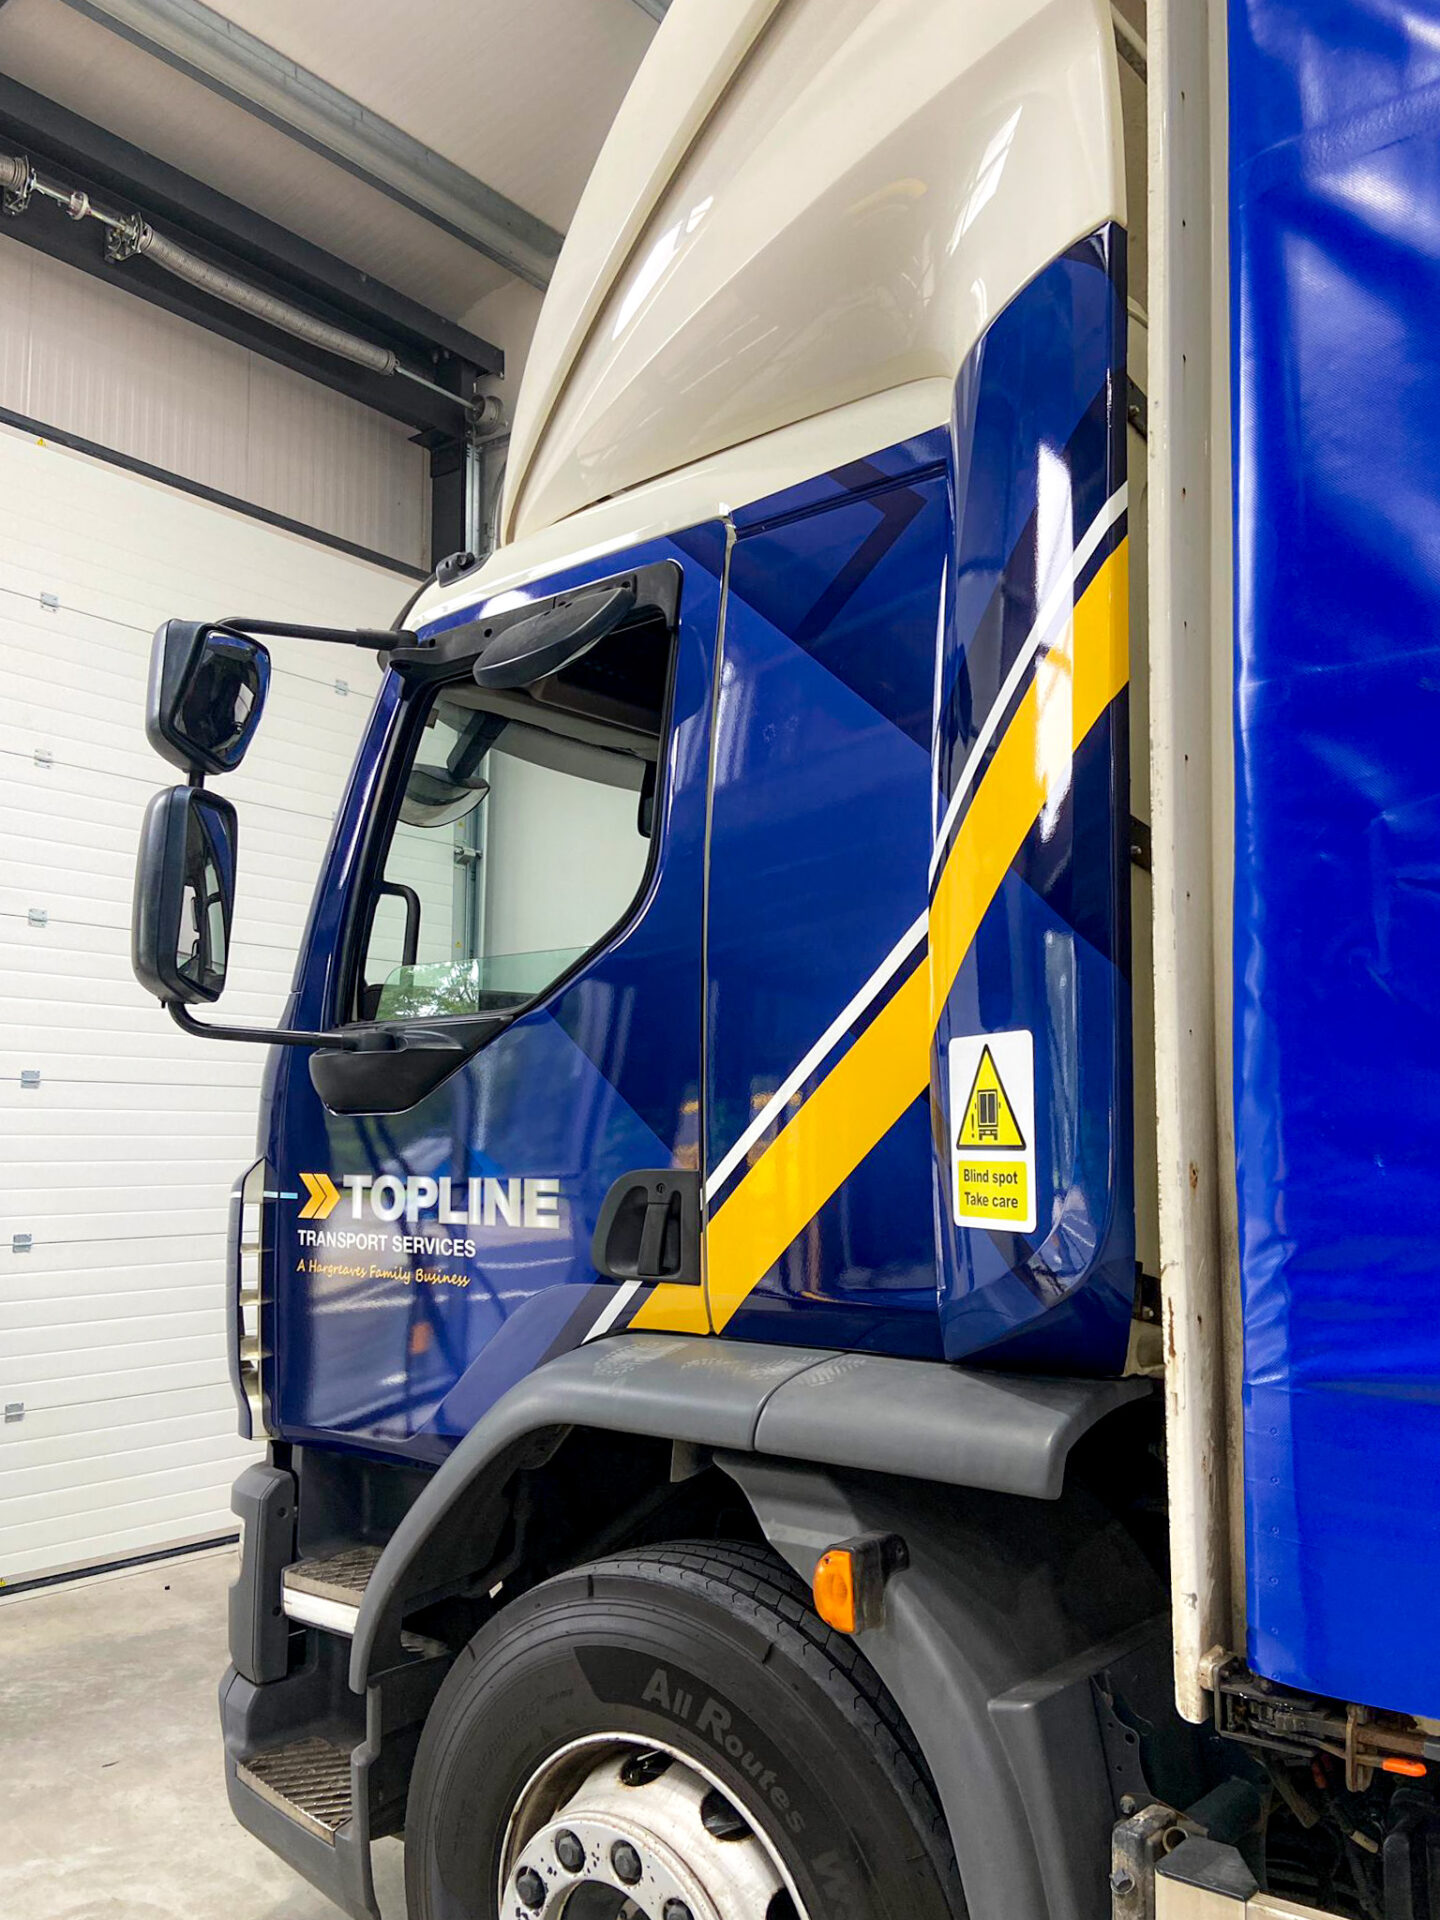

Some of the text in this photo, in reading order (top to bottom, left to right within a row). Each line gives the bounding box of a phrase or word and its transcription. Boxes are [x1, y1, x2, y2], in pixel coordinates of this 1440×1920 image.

[963, 1168, 1018, 1188] Blind spot
[342, 1174, 560, 1230] TOPLINE
[964, 1191, 1019, 1209] Take care
[297, 1229, 477, 1258] TRANSPORT SERVICES
[296, 1258, 471, 1288] A Hargreaves Family Business
[640, 1668, 807, 1834] All Routes
